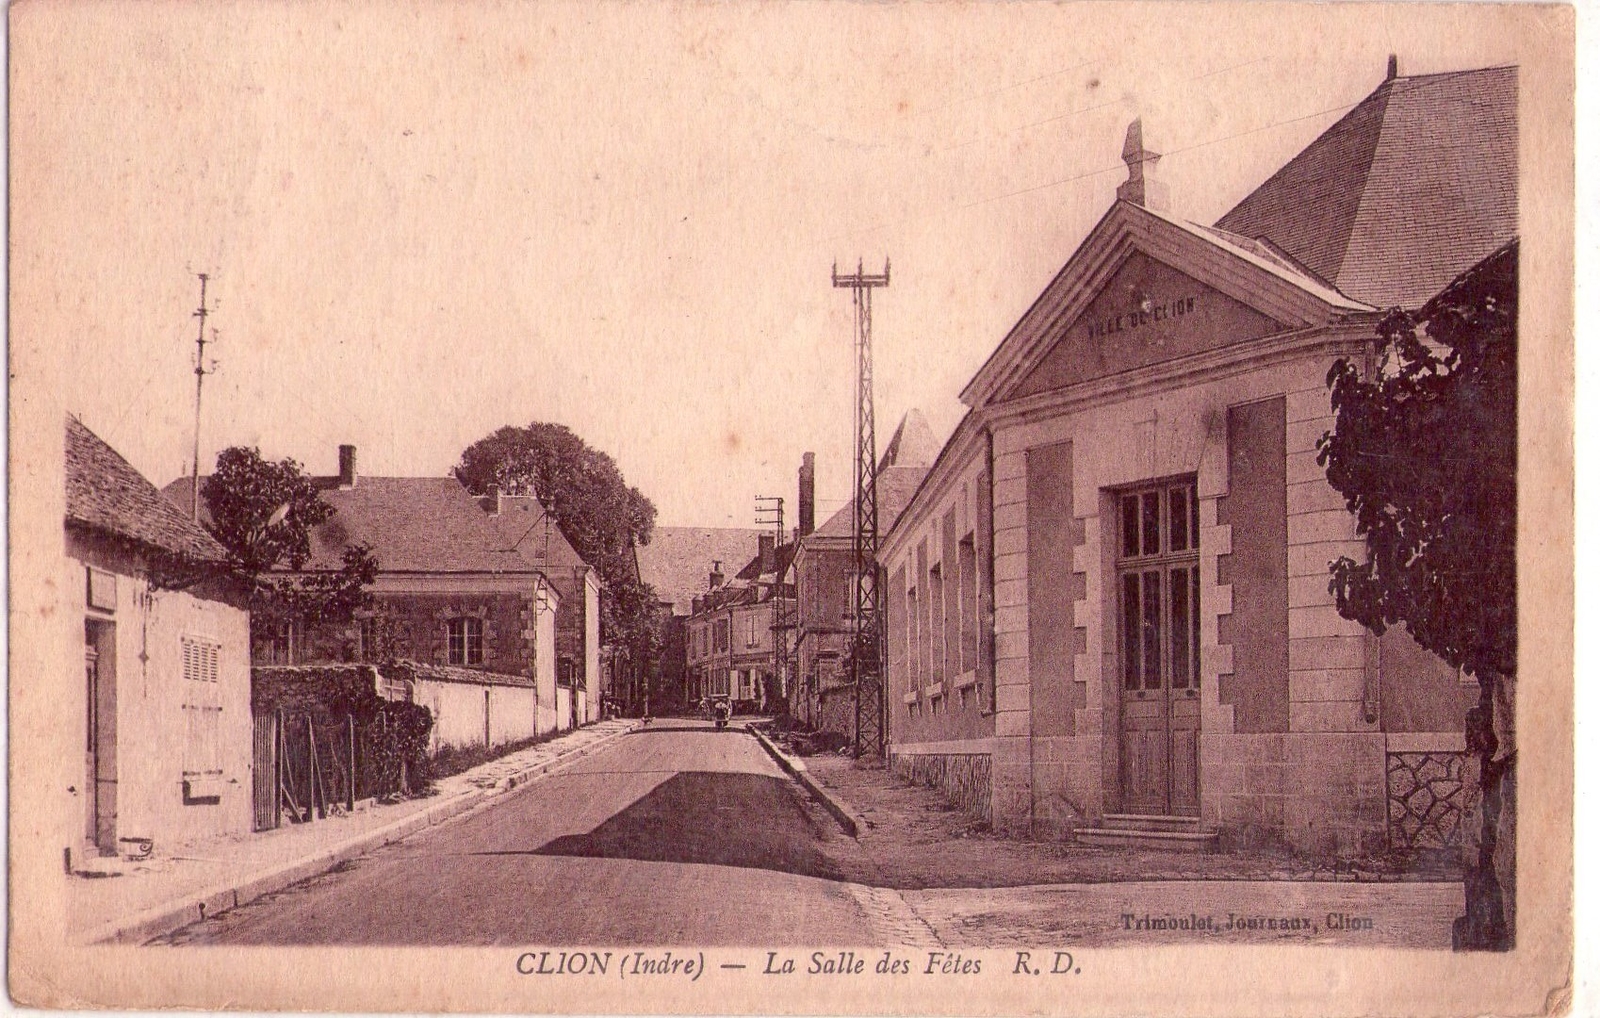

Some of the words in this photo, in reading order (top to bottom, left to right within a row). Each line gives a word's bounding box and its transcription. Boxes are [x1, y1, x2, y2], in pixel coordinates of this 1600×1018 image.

[1088, 315, 1123, 339] VILLE
[1130, 309, 1147, 328] DE
[1154, 297, 1194, 322] CLION
